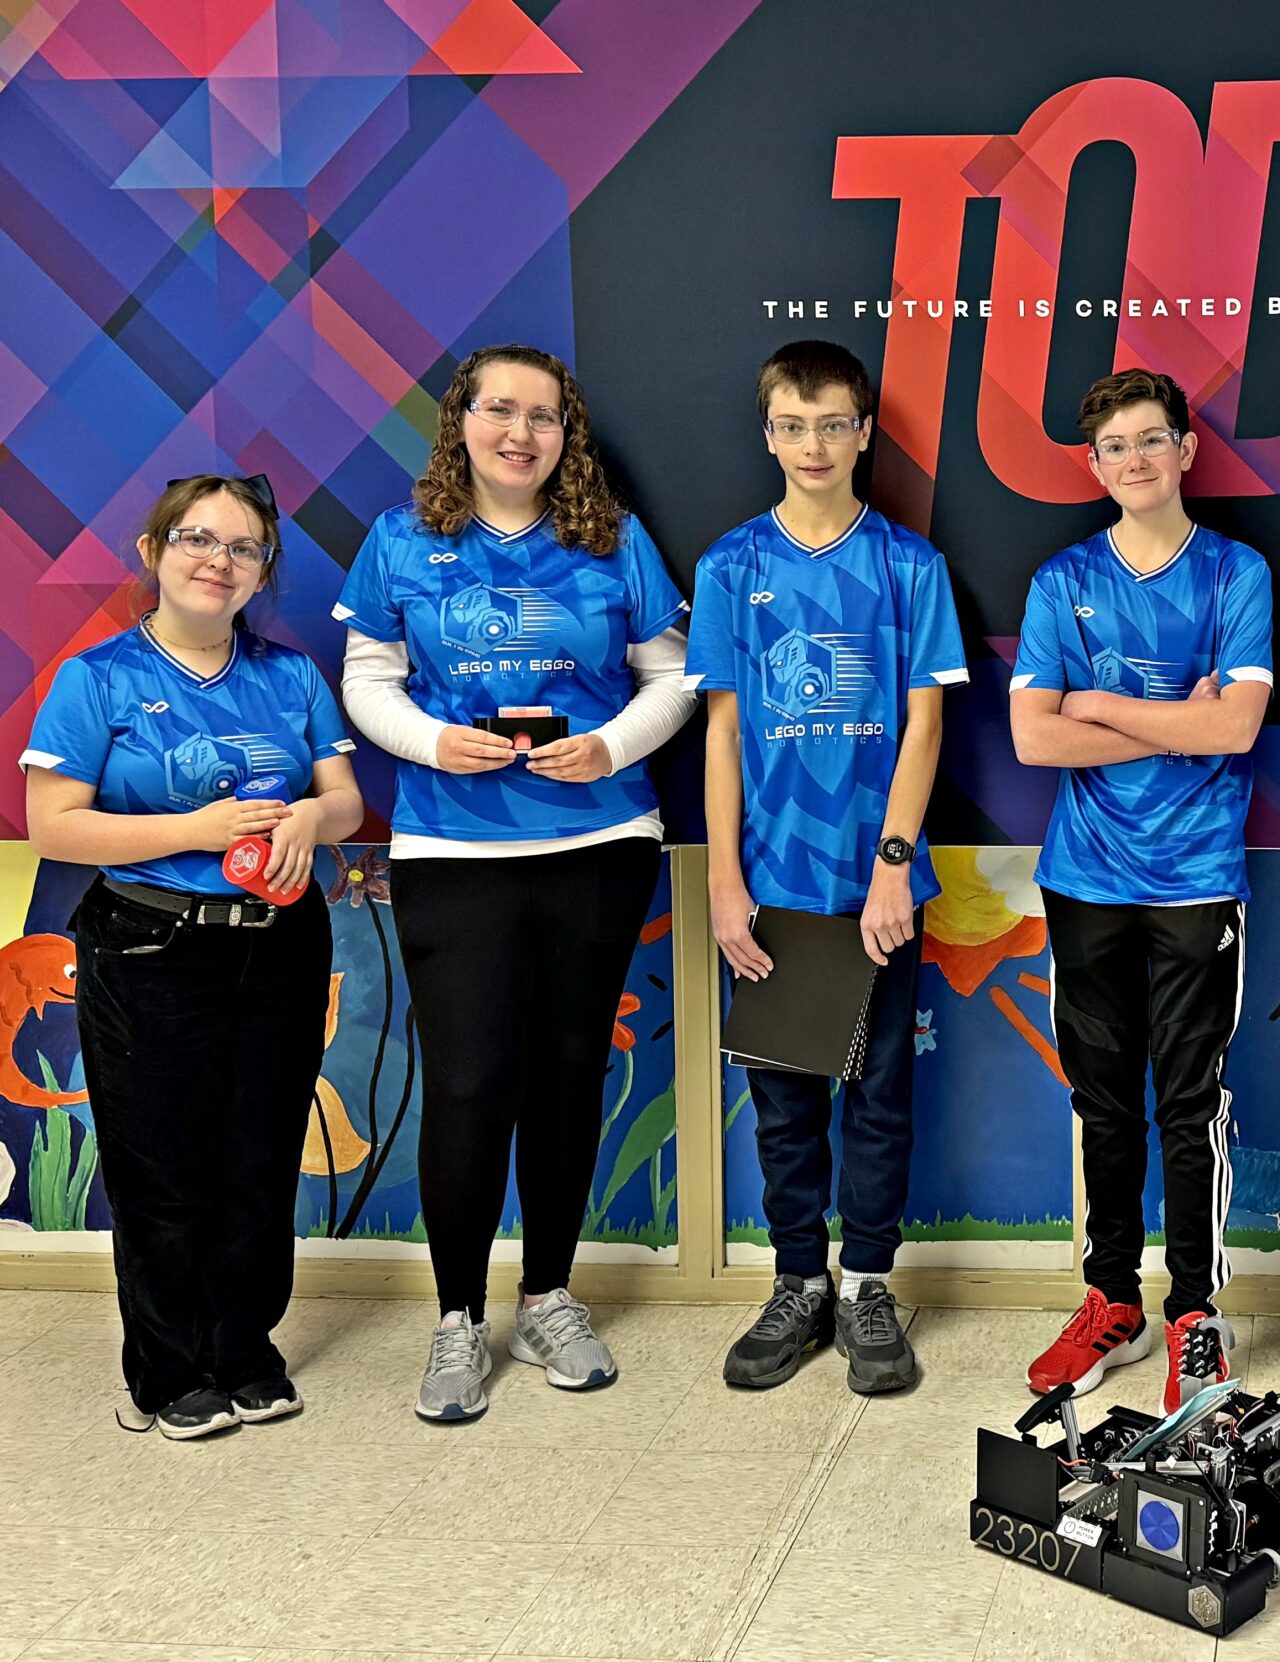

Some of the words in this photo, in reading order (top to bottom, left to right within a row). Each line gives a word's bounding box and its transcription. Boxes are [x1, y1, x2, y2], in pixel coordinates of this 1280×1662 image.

[762, 300, 829, 319] THE
[854, 299, 993, 319] FUTURE
[1018, 298, 1051, 318] IS
[1075, 297, 1242, 318] CREATED
[448, 660, 493, 675] LEGO
[499, 659, 522, 672] MY
[529, 659, 575, 671] EGGO
[765, 723, 806, 740] LEGO
[812, 723, 836, 736] MY
[843, 723, 884, 736] EGGO
[767, 737, 882, 749] ROBOTICS
[975, 1507, 1082, 1577] 23207
